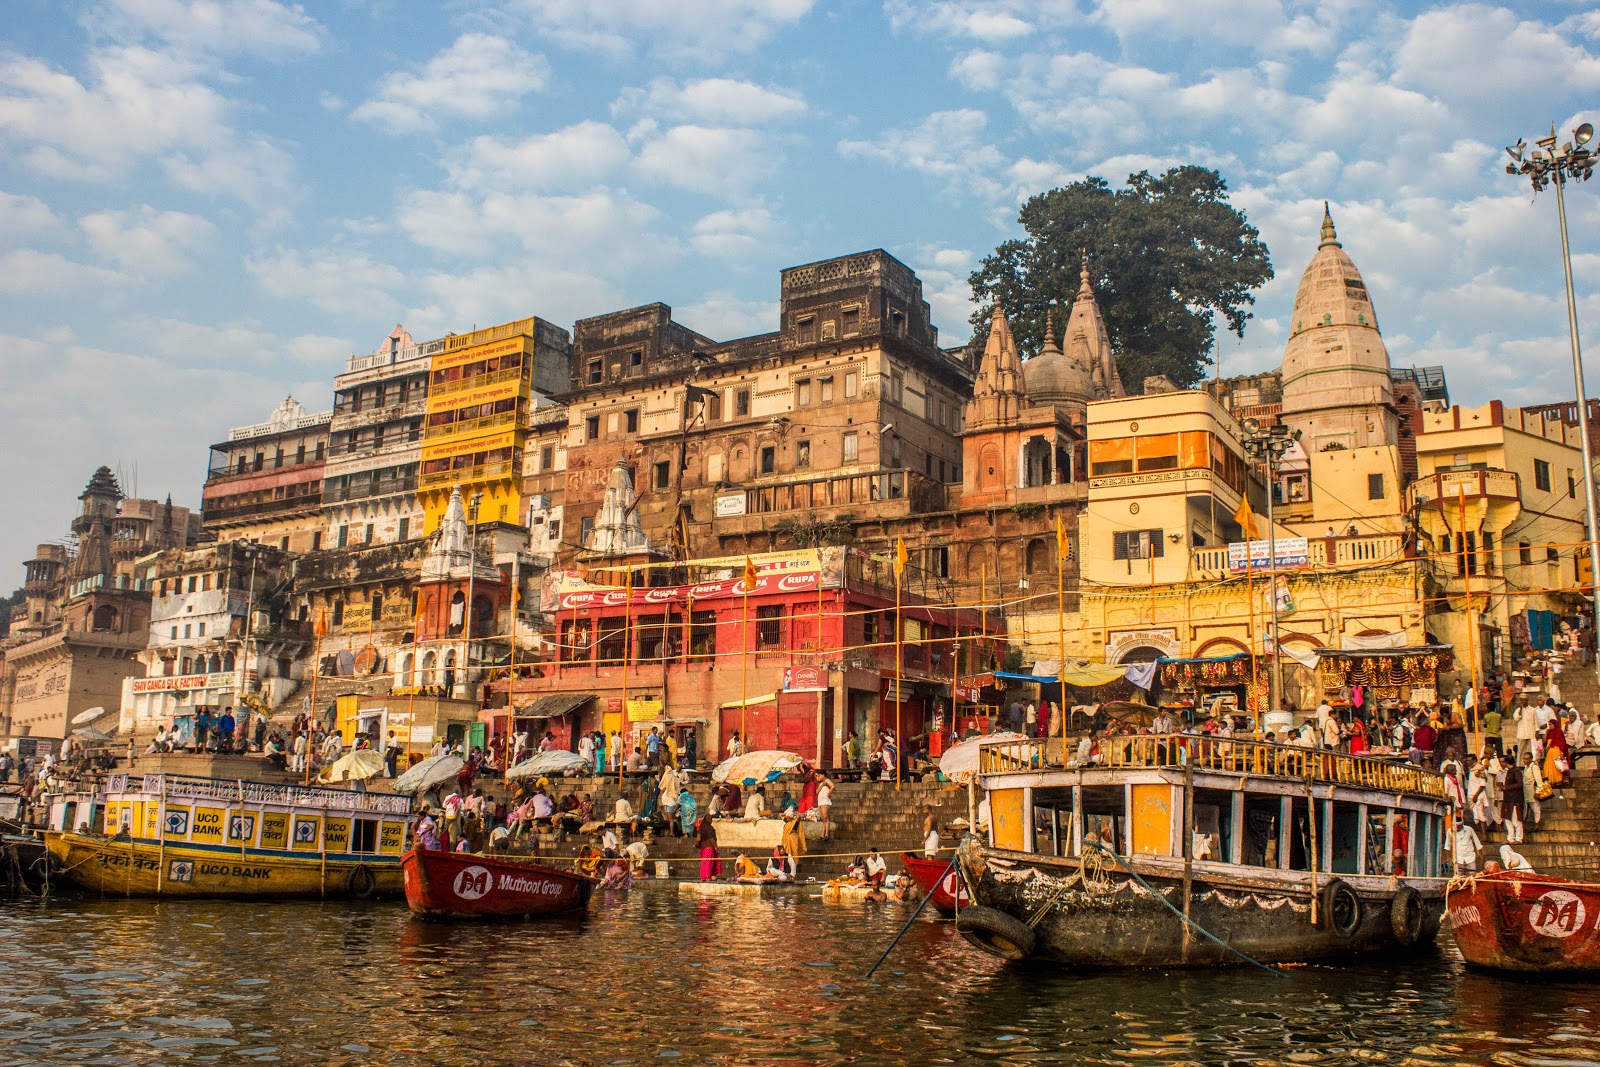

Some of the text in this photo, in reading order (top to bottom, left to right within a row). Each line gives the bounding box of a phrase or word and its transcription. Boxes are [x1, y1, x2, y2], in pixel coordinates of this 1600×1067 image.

[740, 579, 768, 588] RPA
[788, 574, 815, 584] RUPA
[696, 583, 722, 593] RUPA
[570, 594, 595, 602] RUPA
[133, 681, 147, 692] SHIV
[147, 679, 165, 691] GANGA
[167, 679, 179, 689] SILK
[180, 675, 208, 689] FACTORY
[197, 813, 219, 823] UCO
[193, 825, 222, 836] BANK
[327, 823, 346, 832] UCO
[200, 864, 272, 879] UCO BANK
[498, 874, 563, 898] Muthoot Group
